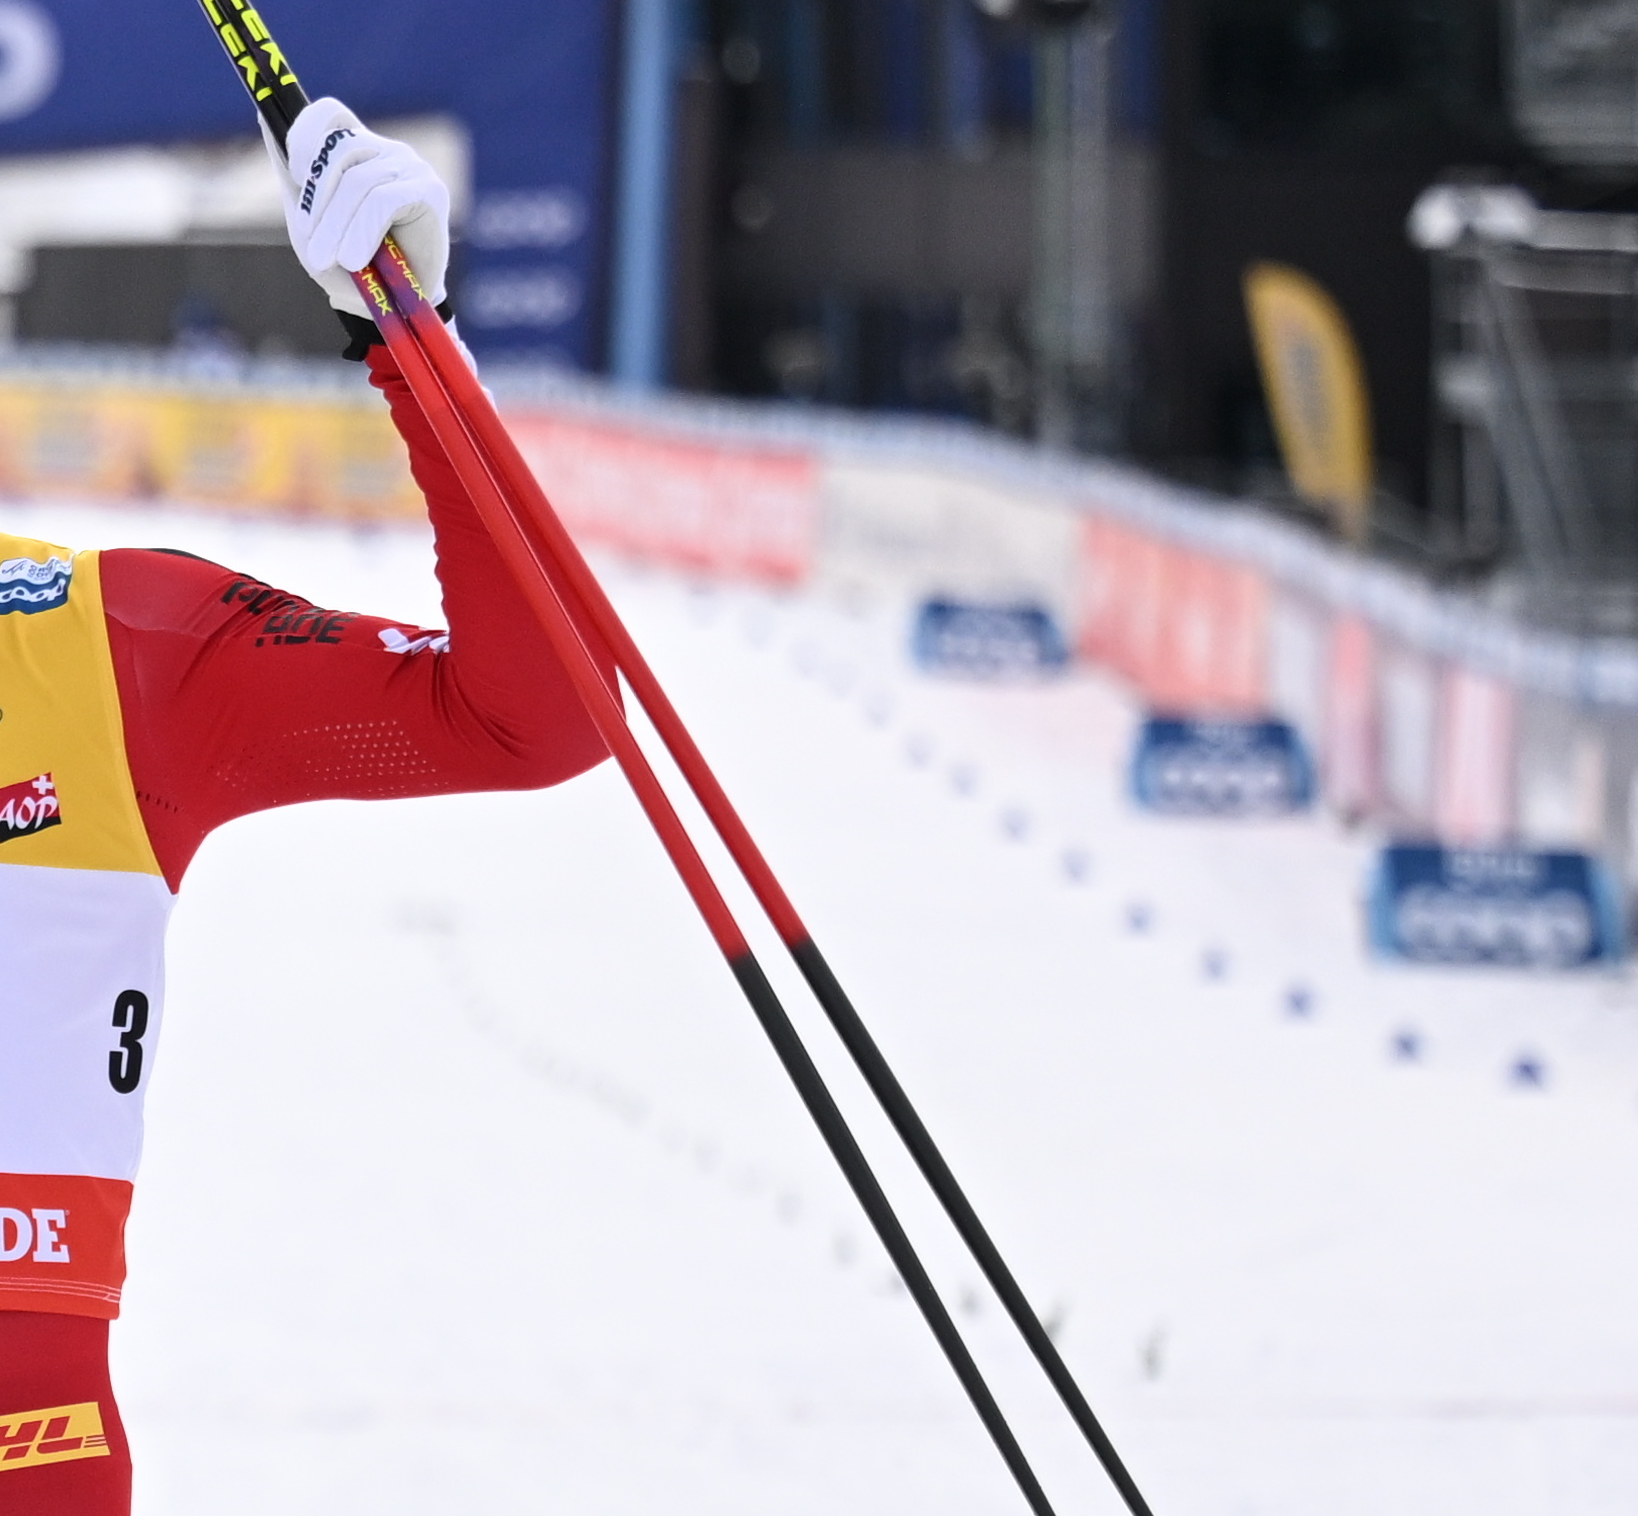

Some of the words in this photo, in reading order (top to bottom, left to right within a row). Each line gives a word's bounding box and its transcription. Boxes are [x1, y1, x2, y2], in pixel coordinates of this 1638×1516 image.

[365, 276, 392, 317] MAX
[400, 259, 427, 302] MAX
[107, 989, 150, 1094] 3
